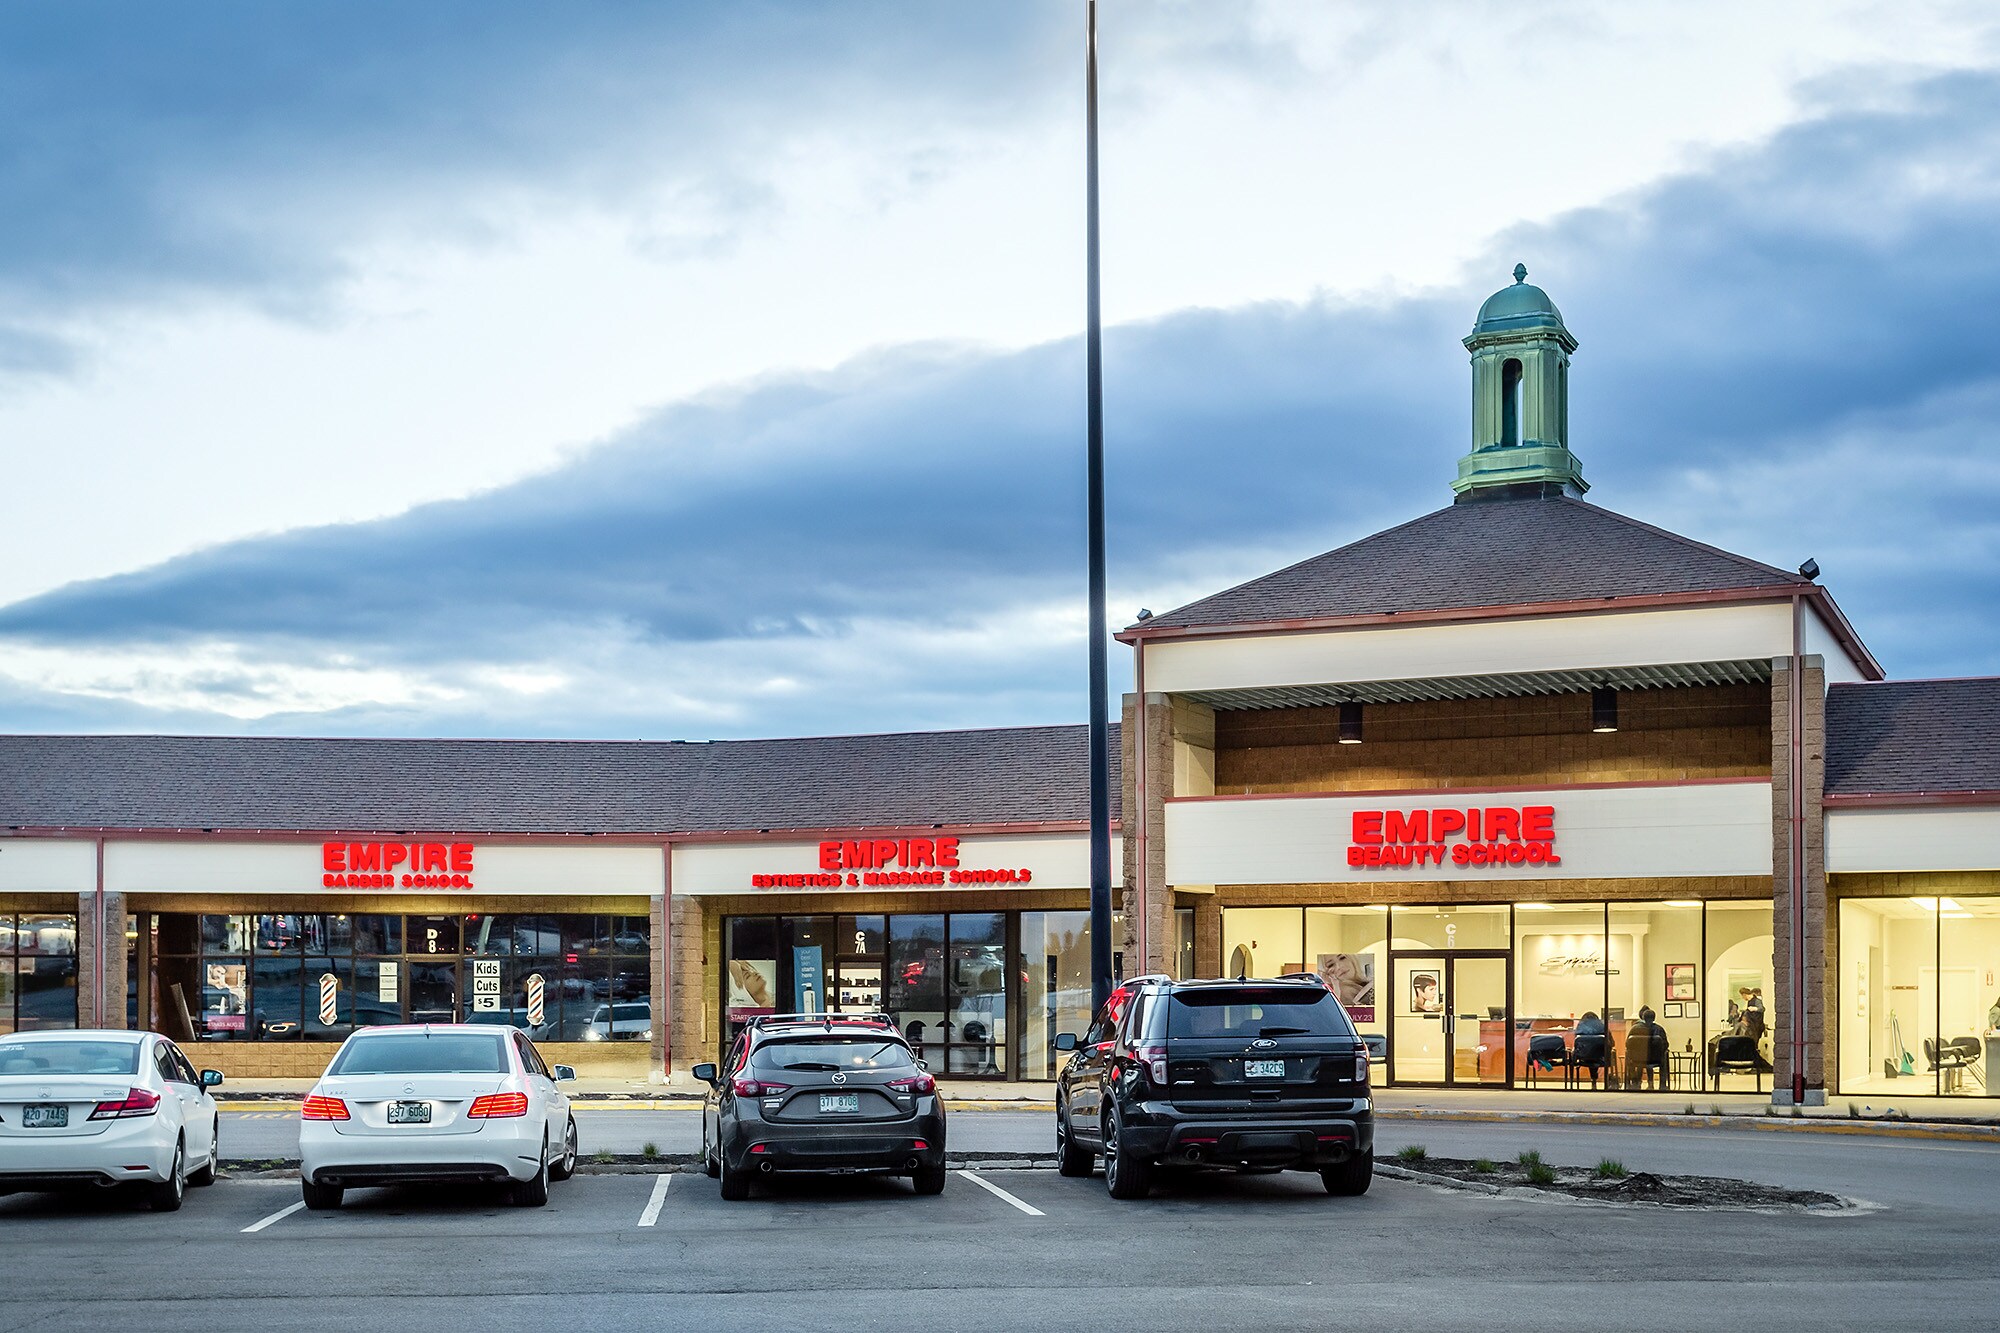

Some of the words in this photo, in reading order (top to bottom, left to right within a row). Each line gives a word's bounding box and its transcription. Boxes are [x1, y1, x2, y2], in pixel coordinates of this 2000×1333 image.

[1352, 806, 1556, 844] EMPIRE
[323, 842, 474, 872] EMPIRE
[818, 837, 960, 870] EMPIRE
[1347, 845, 1447, 867] BEAUTY
[1451, 842, 1561, 865] SCHOOL
[322, 873, 395, 888] BARBER
[401, 874, 474, 888] SCHOOL
[752, 873, 842, 887] ESTHETICS
[846, 873, 859, 886] &
[863, 871, 945, 885] MASSAGE
[949, 868, 1032, 884] SCHOOLS
[426, 928, 438, 939] D
[1445, 923, 1457, 935] C
[855, 931, 866, 941] C
[1447, 935, 1455, 949] 6
[428, 940, 437, 953] 8
[855, 941, 867, 954] 7A
[476, 963, 498, 974] Kids
[476, 980, 498, 991] Cuts
[477, 997, 495, 1008] $5
[1259, 1063, 1284, 1074] 342C9
[820, 1097, 834, 1107] 371
[838, 1096, 858, 1106] 8708
[25, 1109, 41, 1120] 420
[45, 1109, 66, 1120] 7449
[390, 1107, 405, 1118] 297
[408, 1106, 429, 1117] 6080
